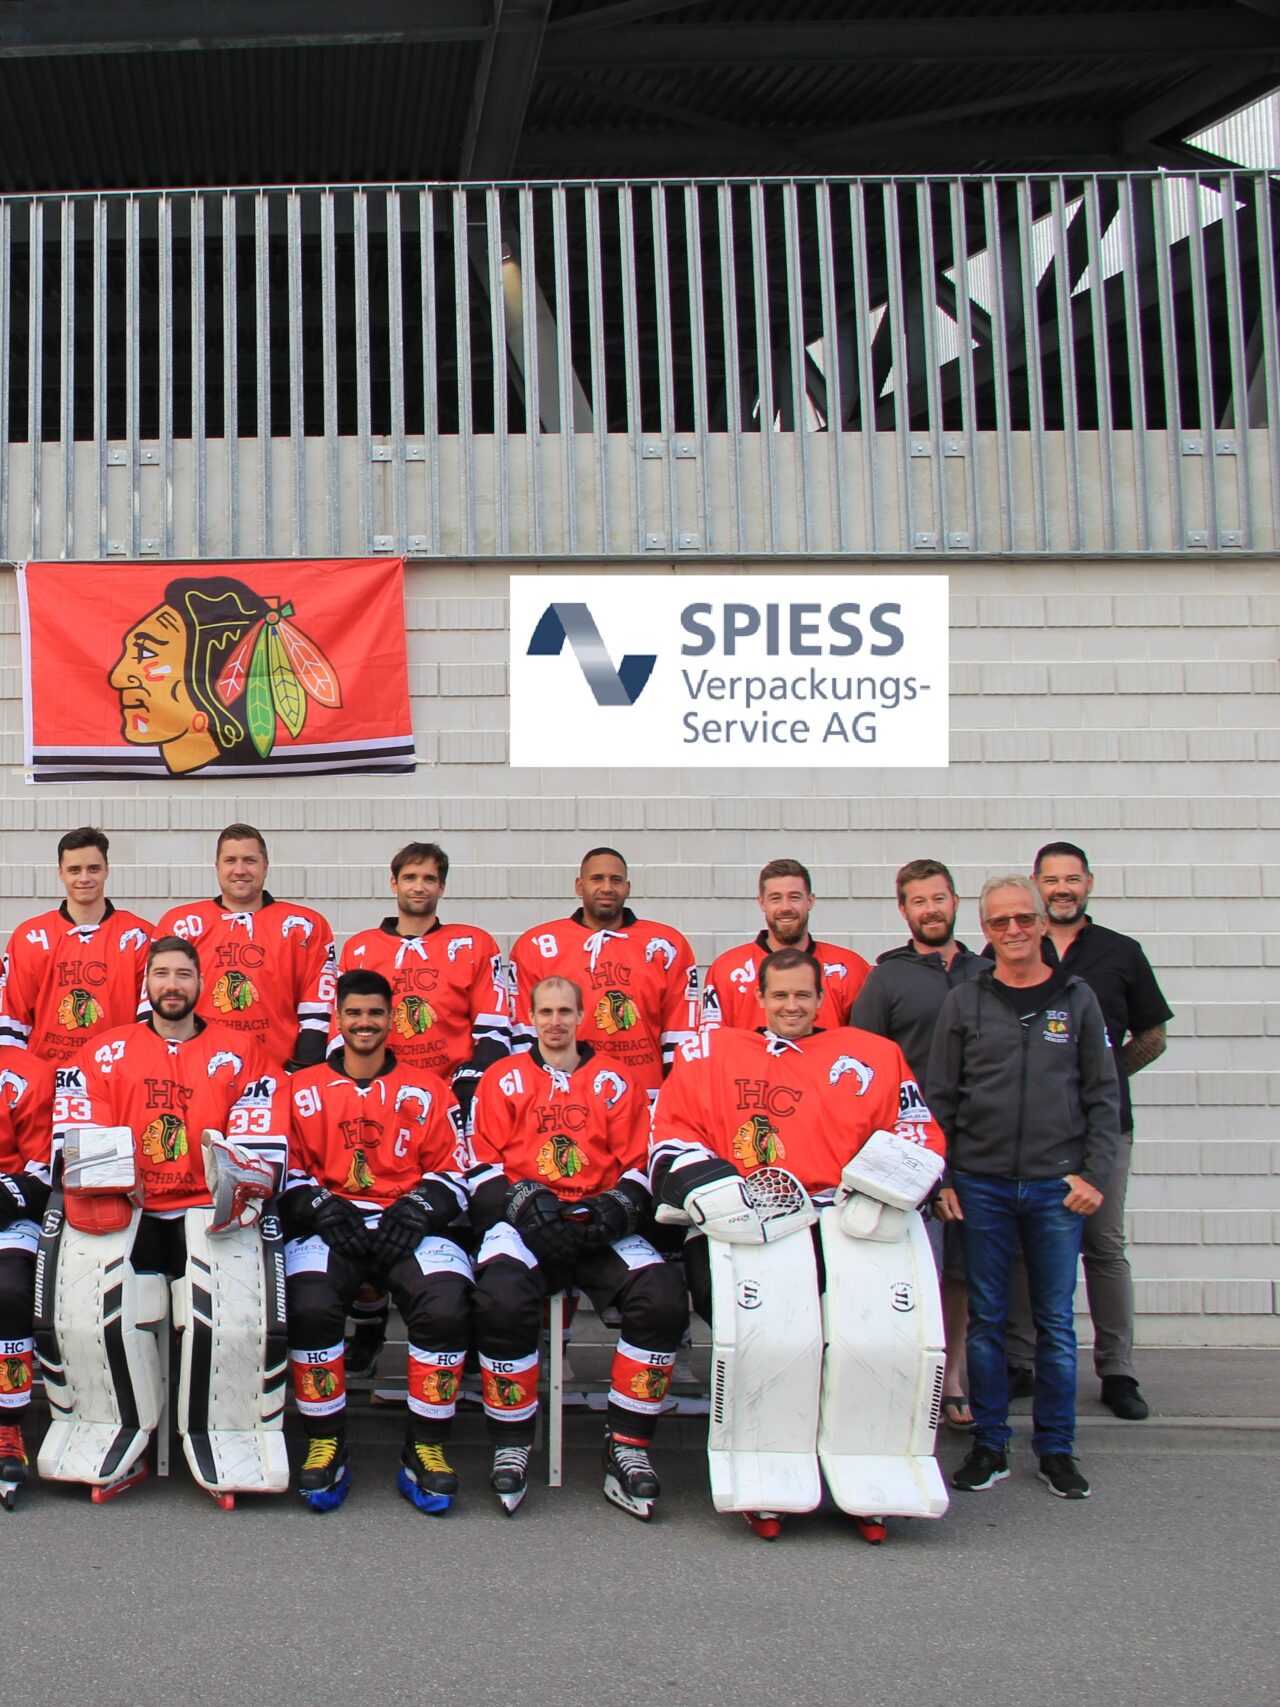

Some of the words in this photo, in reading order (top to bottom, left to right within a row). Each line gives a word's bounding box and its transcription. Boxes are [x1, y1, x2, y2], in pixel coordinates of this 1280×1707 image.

[215, 942, 266, 968] HC
[57, 960, 108, 986] HC
[392, 967, 440, 994] HC
[1046, 1010, 1068, 1020] HC
[144, 1079, 195, 1111] HC
[294, 1085, 323, 1117] 91
[734, 1079, 802, 1117] HC
[52, 1097, 92, 1122] 33
[229, 1108, 272, 1133] 33
[533, 1104, 589, 1133] HC
[338, 1116, 384, 1149] HC
[394, 1128, 411, 1157] C
[34, 1249, 47, 1319] WARRIOR
[274, 1251, 287, 1323] WARRIOR
[4, 1341, 24, 1354] HC
[306, 1351, 329, 1364] HC
[437, 1354, 458, 1366] HC
[649, 1353, 671, 1366] HC
[491, 1361, 515, 1374] HC
